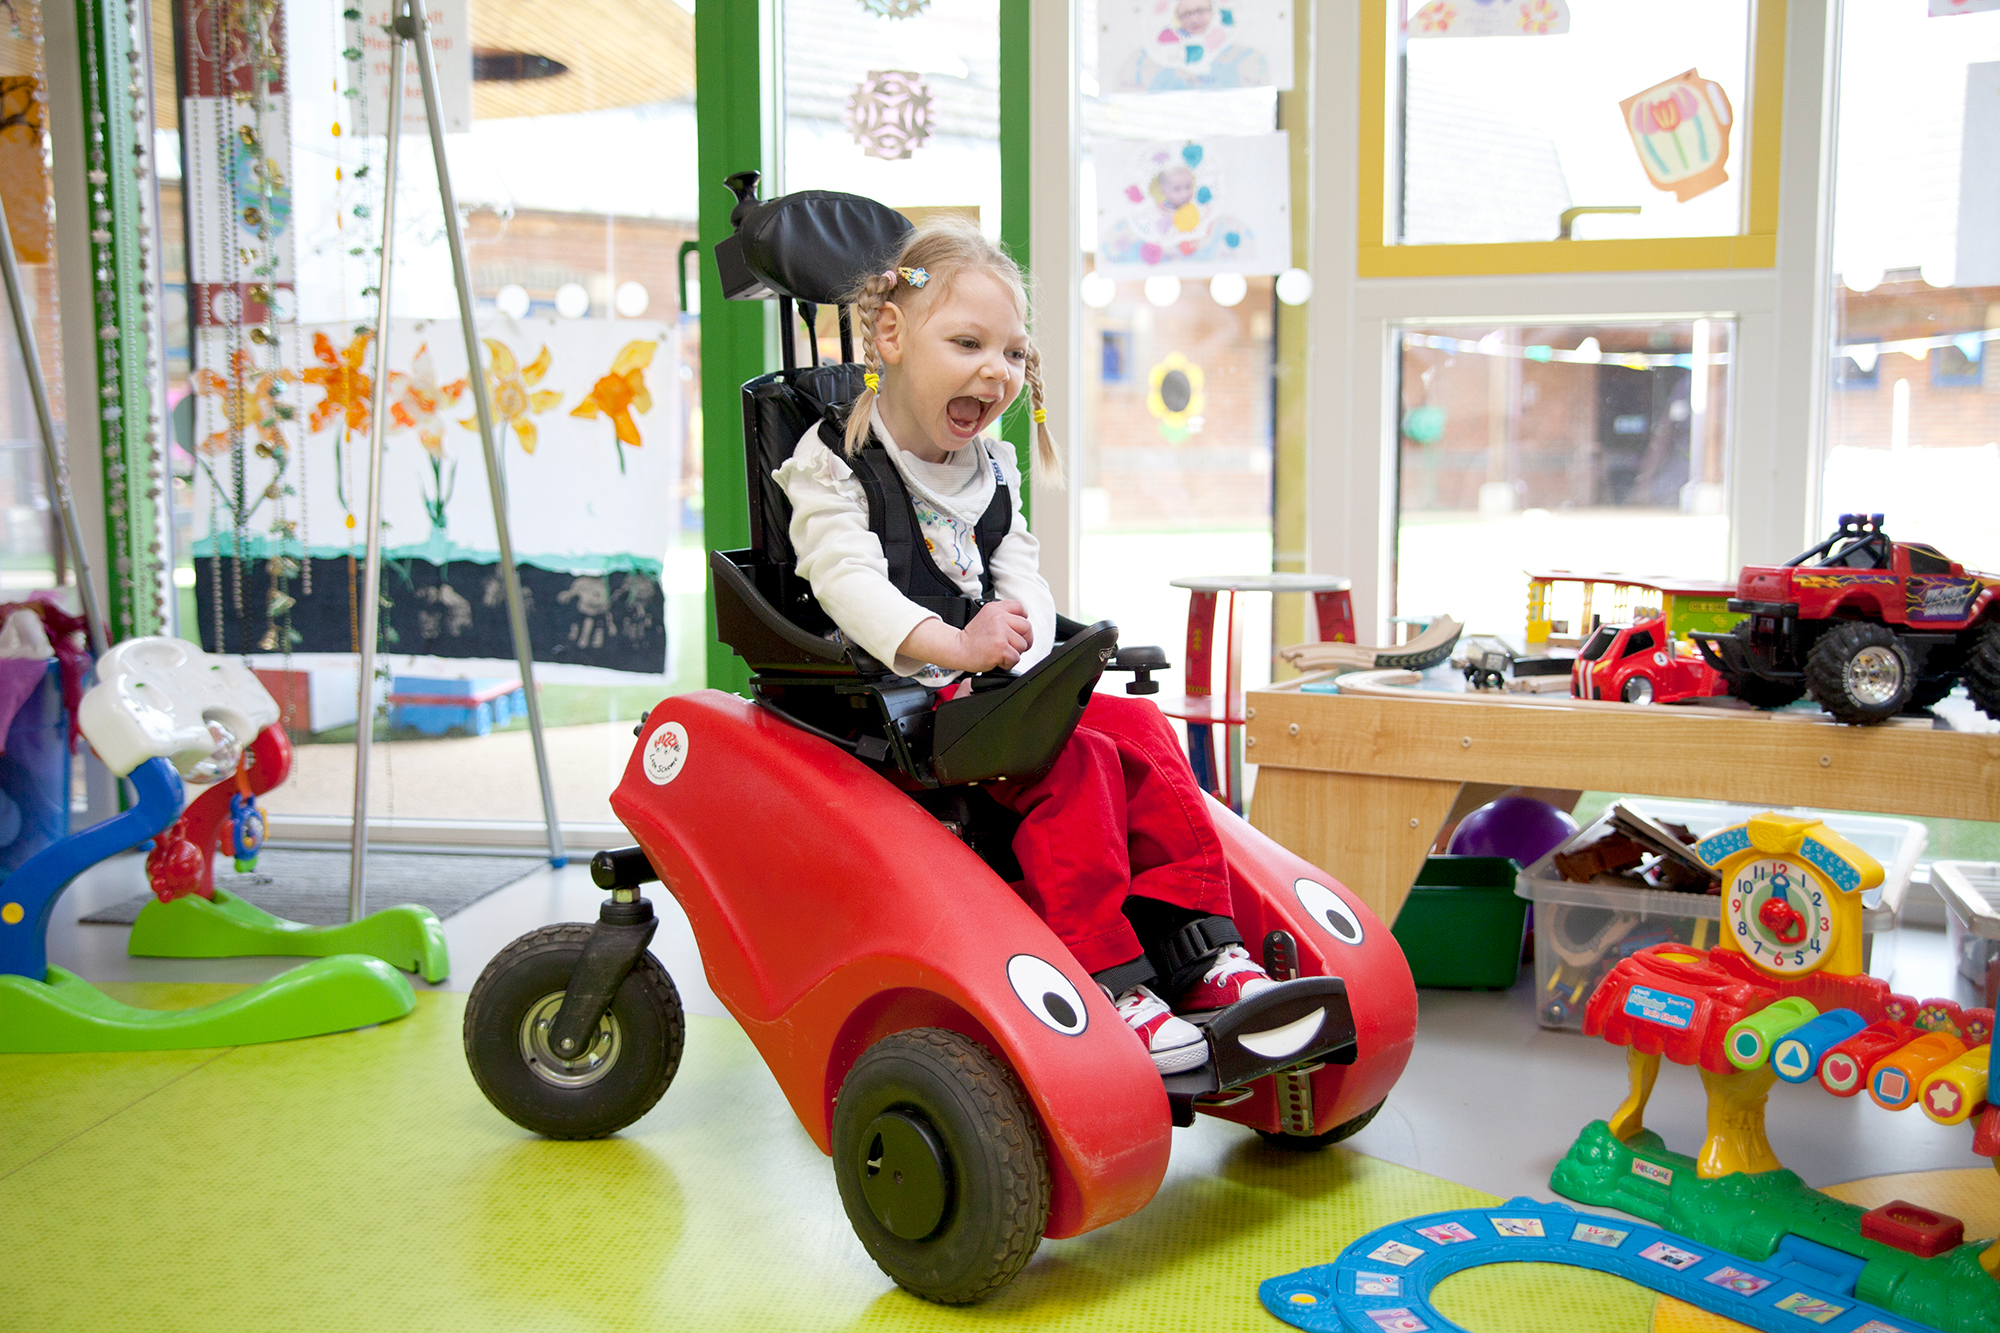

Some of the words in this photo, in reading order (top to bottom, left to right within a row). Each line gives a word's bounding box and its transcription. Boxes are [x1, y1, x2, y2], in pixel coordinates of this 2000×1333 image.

[1754, 865, 1764, 881] 11
[1773, 863, 1788, 879] 12
[1738, 879, 1753, 894] 10
[1802, 874, 1806, 888] 1
[1732, 899, 1742, 913] 9
[1812, 892, 1821, 907] 2
[1738, 921, 1747, 936] 8
[1819, 916, 1830, 932] 3
[1753, 940, 1762, 955] 7
[1810, 938, 1821, 954] 4
[1773, 951, 1784, 966] 6
[1794, 950, 1804, 965] 5
[1643, 1007, 1660, 1019] Train
[1660, 1012, 1686, 1026] Station
[1634, 1161, 1669, 1181] WELCOME
